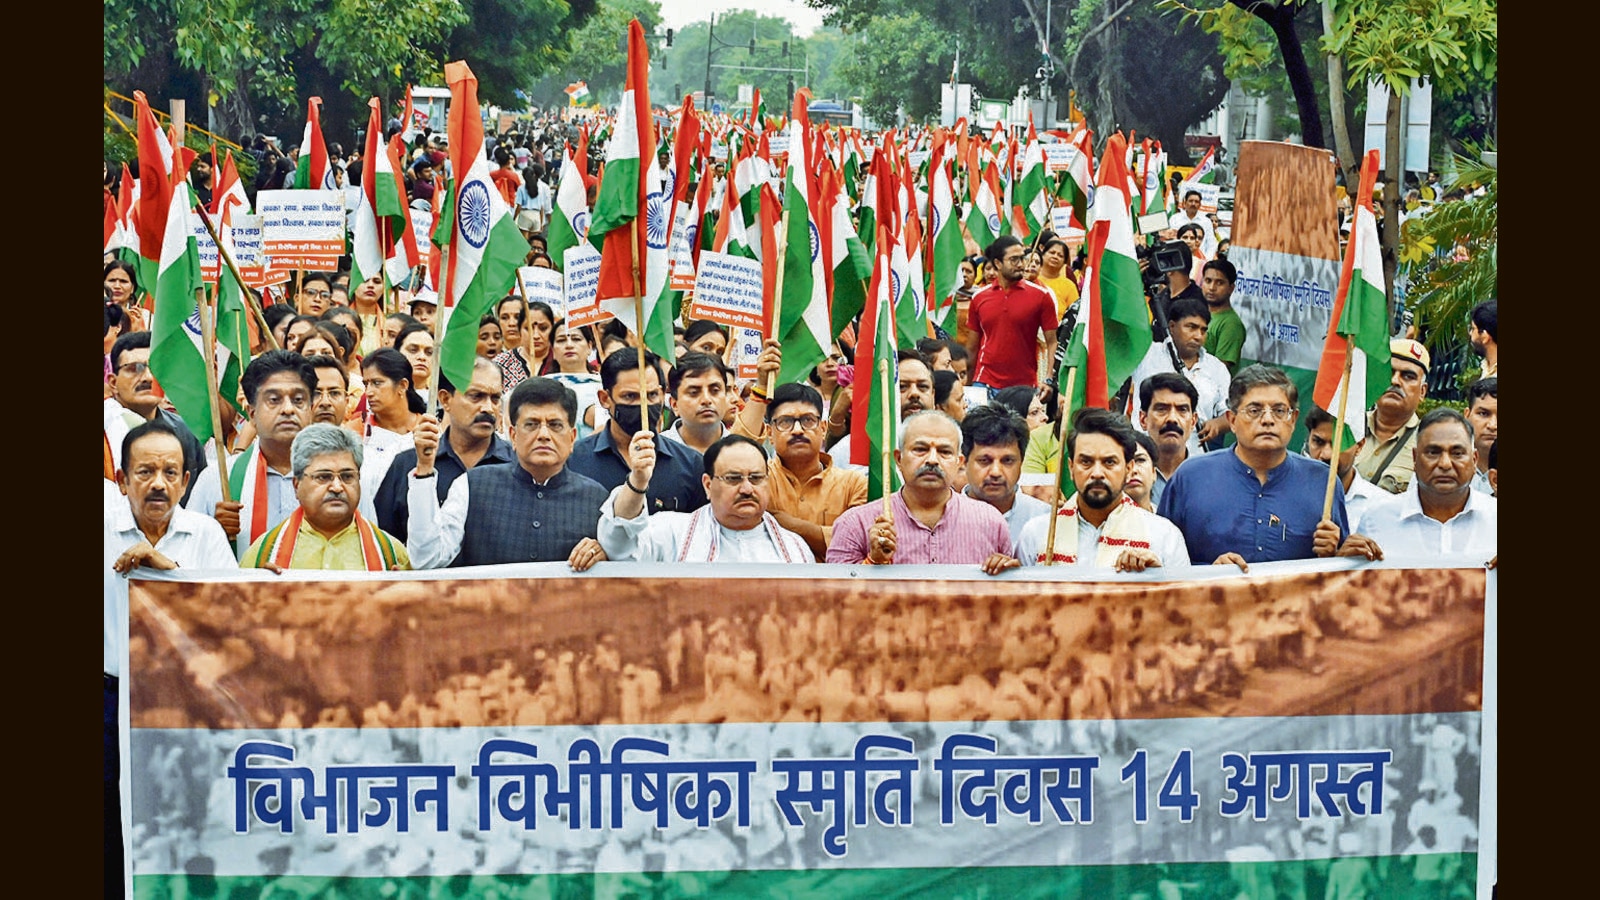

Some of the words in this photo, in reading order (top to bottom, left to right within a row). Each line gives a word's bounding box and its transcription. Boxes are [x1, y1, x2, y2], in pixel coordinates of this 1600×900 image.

[1236, 270, 1260, 297] विभाजन
[1262, 274, 1293, 302] विभीषिका
[1312, 282, 1331, 308] दिवस
[1266, 321, 1276, 338] 14
[1278, 324, 1299, 343] अगस्त
[228, 741, 456, 834] विभाजन
[471, 738, 757, 831] विभीषिका
[771, 735, 919, 857] स्मृति
[934, 733, 1100, 825] दिवस
[1120, 748, 1199, 823] 14
[1220, 749, 1393, 821] अगस्त
